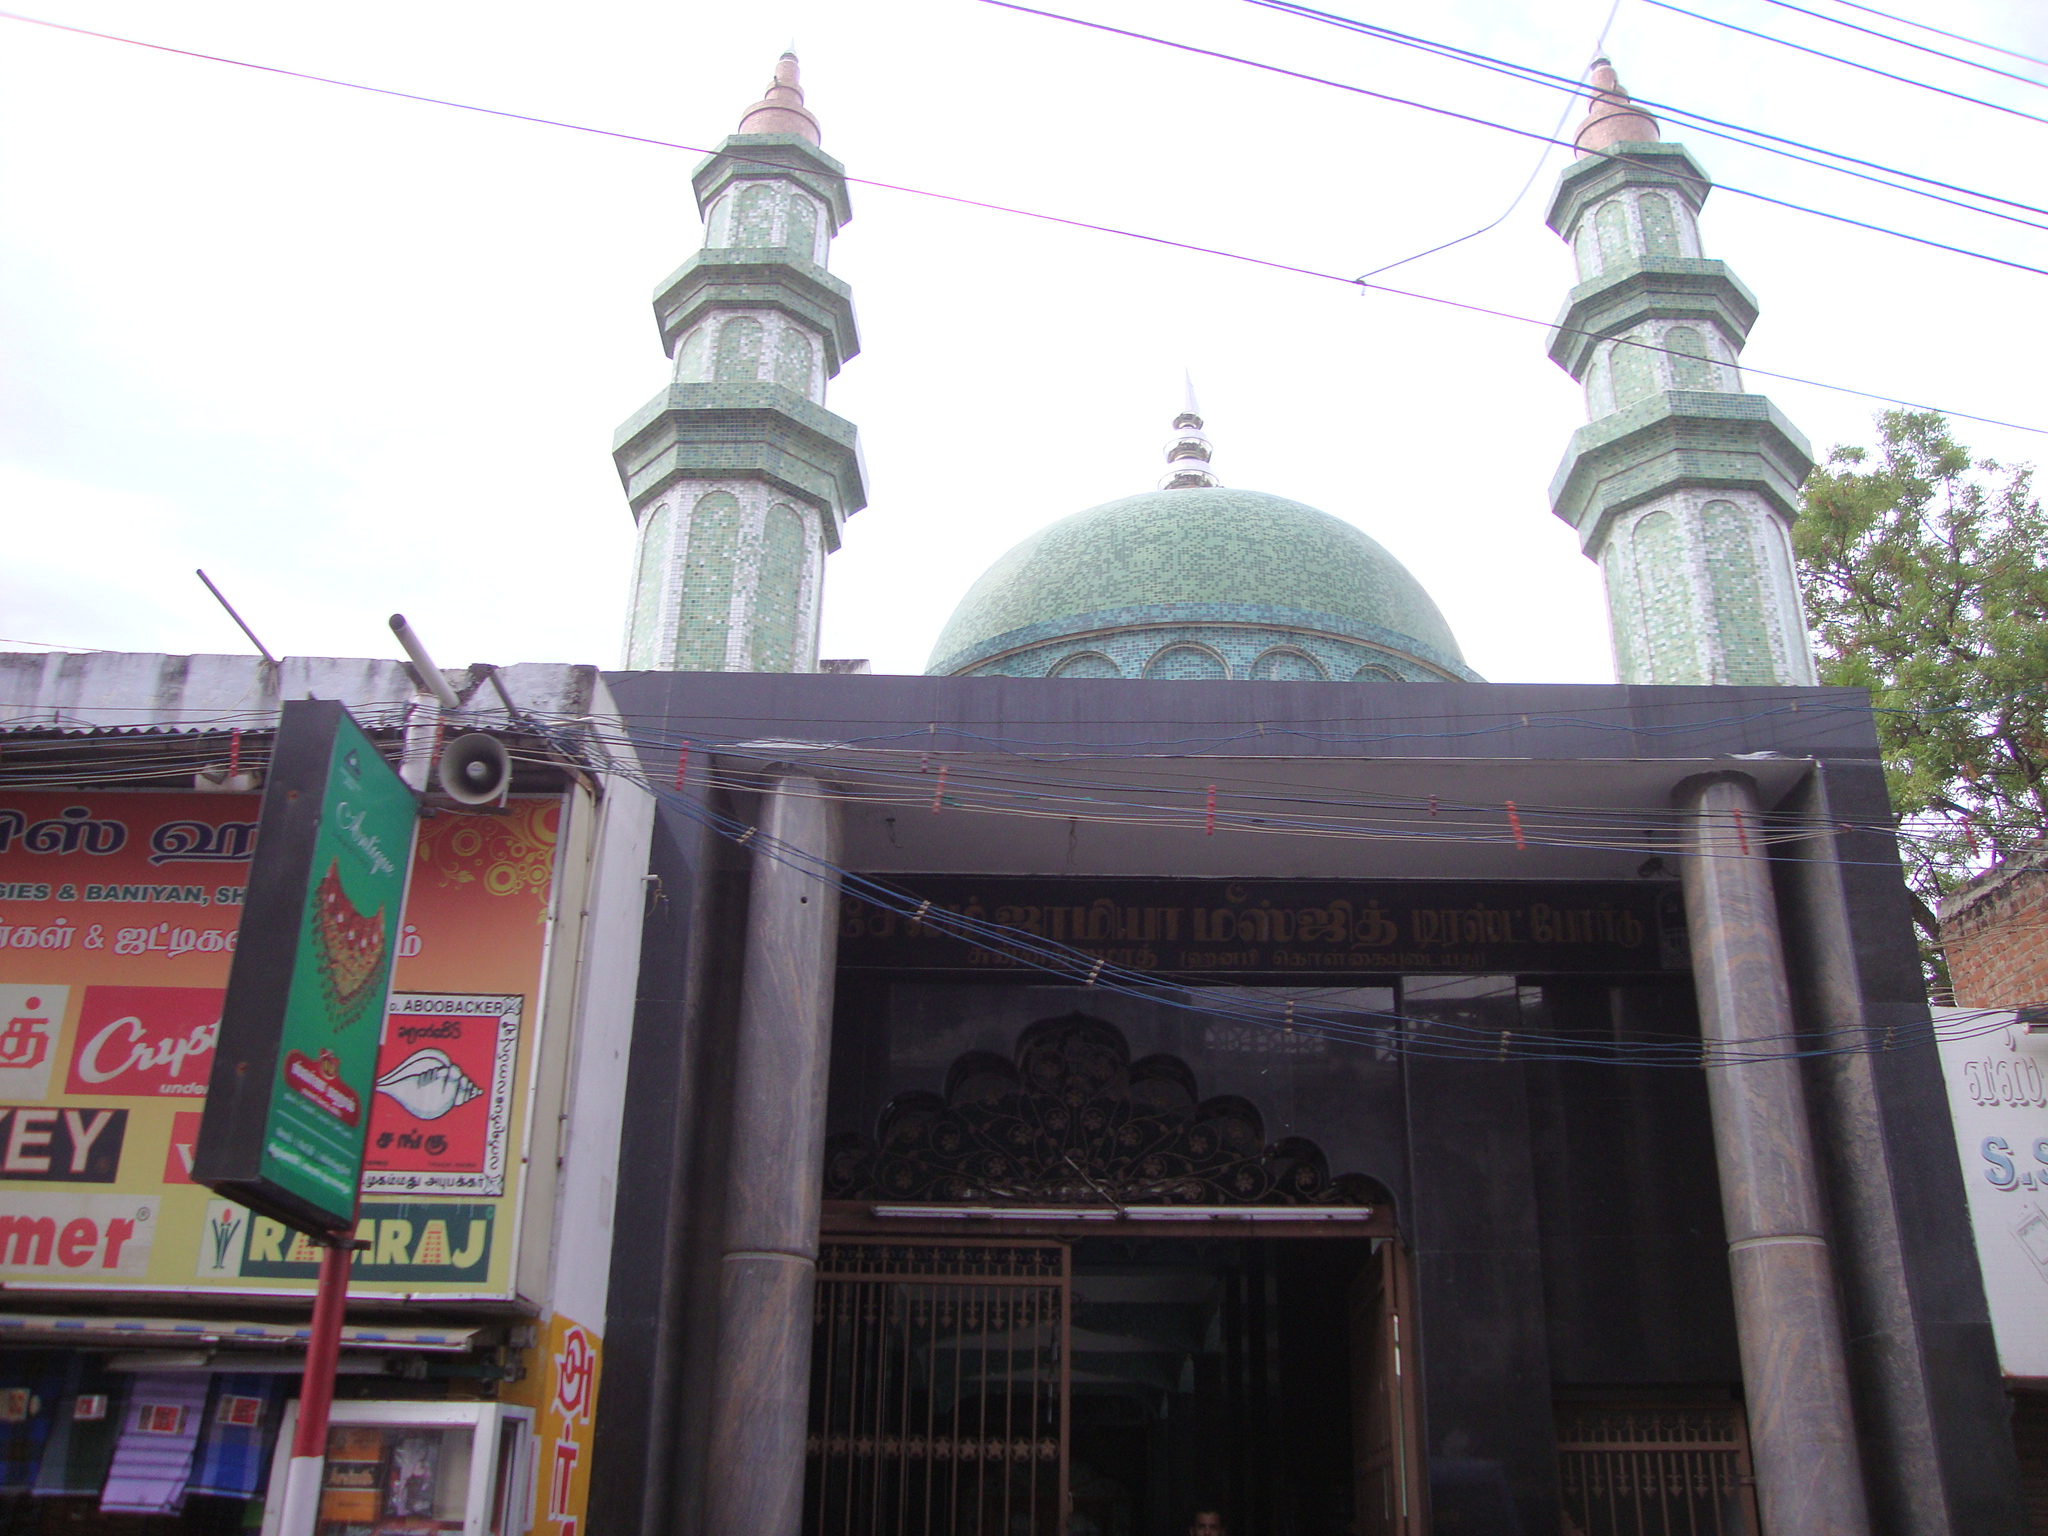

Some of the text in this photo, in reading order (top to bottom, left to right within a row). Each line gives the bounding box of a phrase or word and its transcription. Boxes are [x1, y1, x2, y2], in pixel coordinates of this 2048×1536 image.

[57, 884, 78, 902] &
[85, 884, 209, 906] BANIYAN,
[84, 924, 105, 950] &
[404, 1000, 503, 1014] ABOOBACKER
